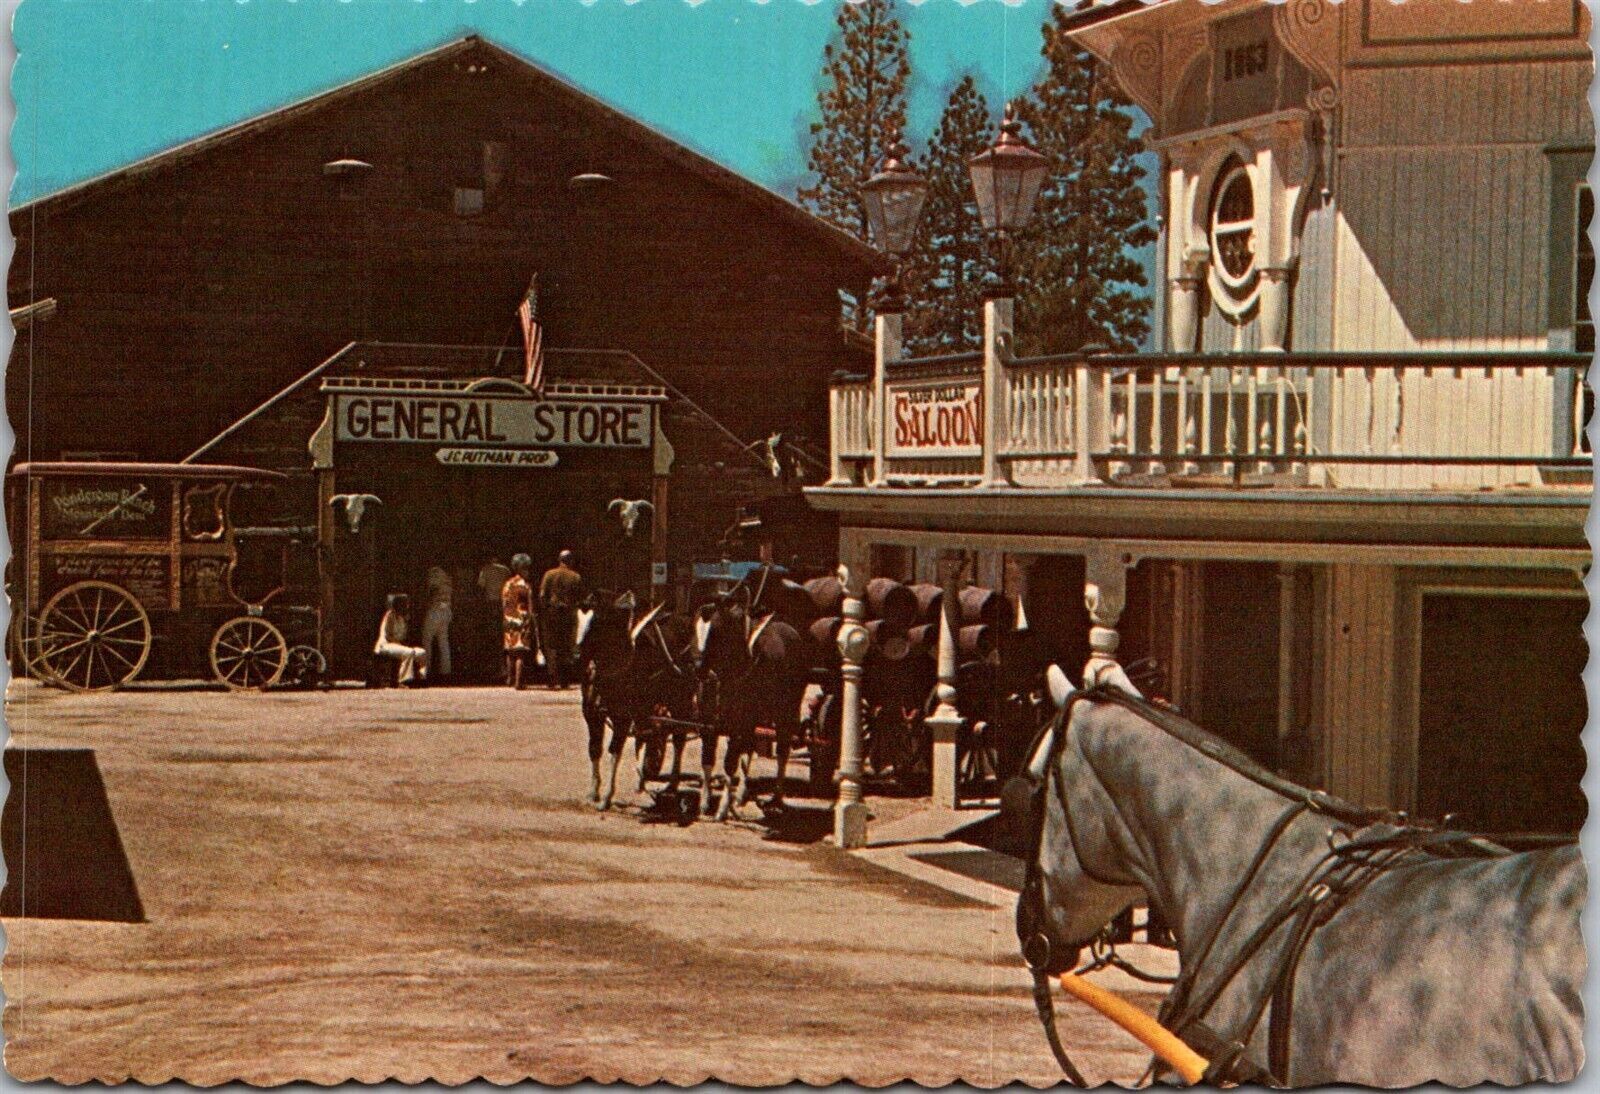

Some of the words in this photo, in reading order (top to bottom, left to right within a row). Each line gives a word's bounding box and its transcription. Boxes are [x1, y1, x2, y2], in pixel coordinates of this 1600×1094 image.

[349, 399, 507, 442] GENERAL
[534, 402, 643, 445] STORE
[895, 394, 982, 447] SALOON
